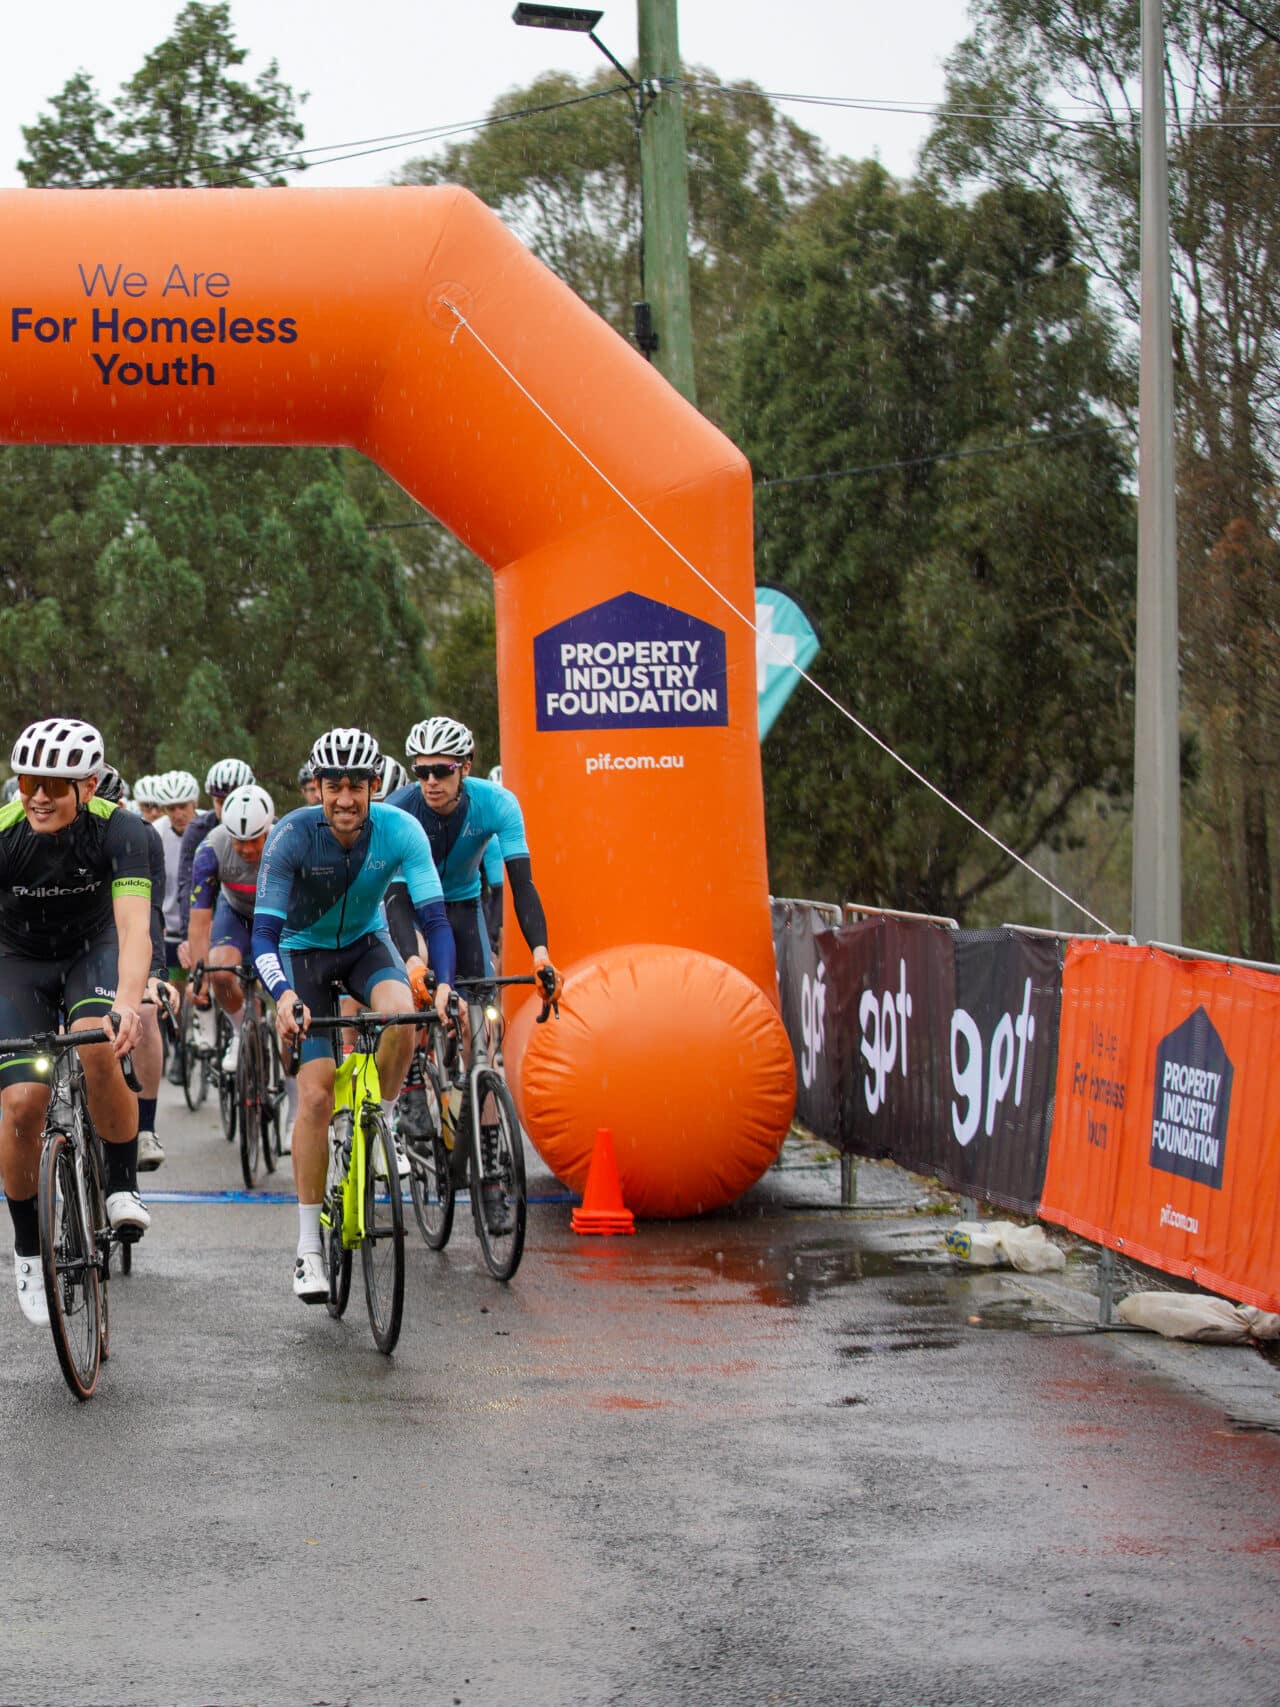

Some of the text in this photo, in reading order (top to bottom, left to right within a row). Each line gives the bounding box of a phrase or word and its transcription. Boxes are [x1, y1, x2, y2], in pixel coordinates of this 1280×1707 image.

[78, 263, 231, 298] We Are
[11, 307, 297, 345] For Homeless
[91, 353, 215, 386] Youth
[560, 640, 701, 667] PROPERTY
[564, 665, 699, 691] INDUSTRY
[546, 688, 718, 716] FOUNDATION
[585, 753, 684, 774] pif.com.au
[858, 957, 913, 1115] gpt
[950, 976, 1035, 1147] gpt
[1163, 1061, 1221, 1102] PROPERTY
[1162, 1092, 1217, 1133] INDUSTRY
[1151, 1120, 1219, 1168] FOUNDATION
